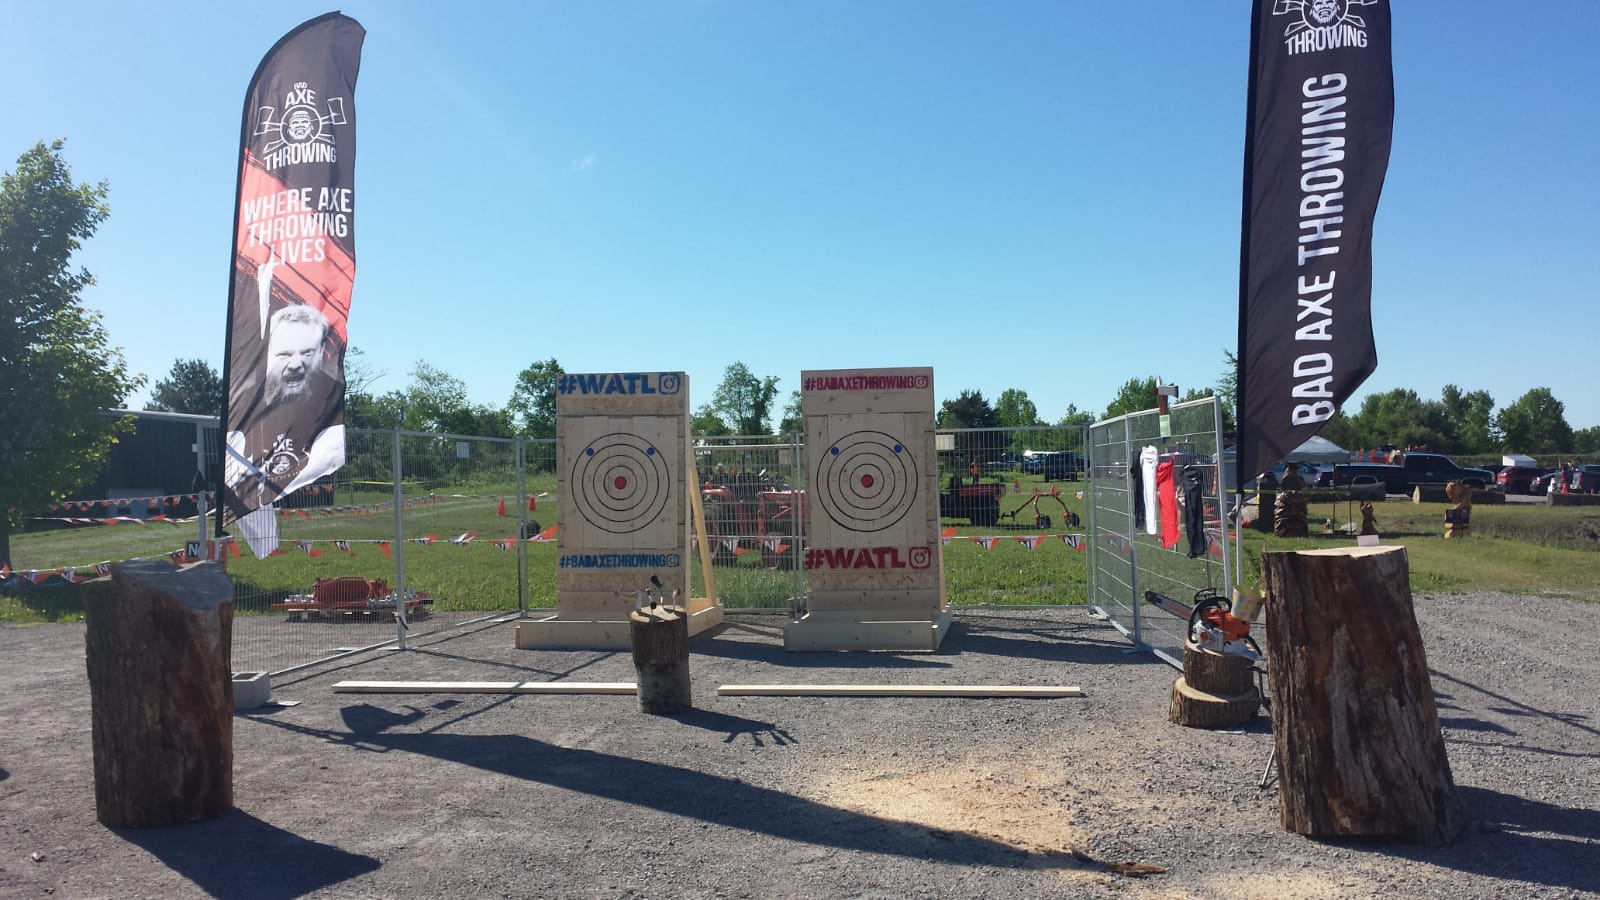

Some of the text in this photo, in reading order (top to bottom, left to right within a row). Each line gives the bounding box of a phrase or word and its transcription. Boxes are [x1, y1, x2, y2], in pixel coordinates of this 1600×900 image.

[1284, 24, 1368, 56] THROWING
[285, 89, 316, 109] AXE
[264, 143, 336, 171] THROWING
[243, 187, 353, 224] WHERE AXE
[247, 213, 348, 248] THROWING
[270, 238, 326, 267] LIVES
[1292, 72, 1348, 427] BAD AXE THROWING
[559, 374, 656, 395] #WATL
[804, 375, 914, 391] #BADAXETHROWING
[560, 554, 666, 568] #BADAXETHROWING
[805, 547, 906, 569] #WATL
